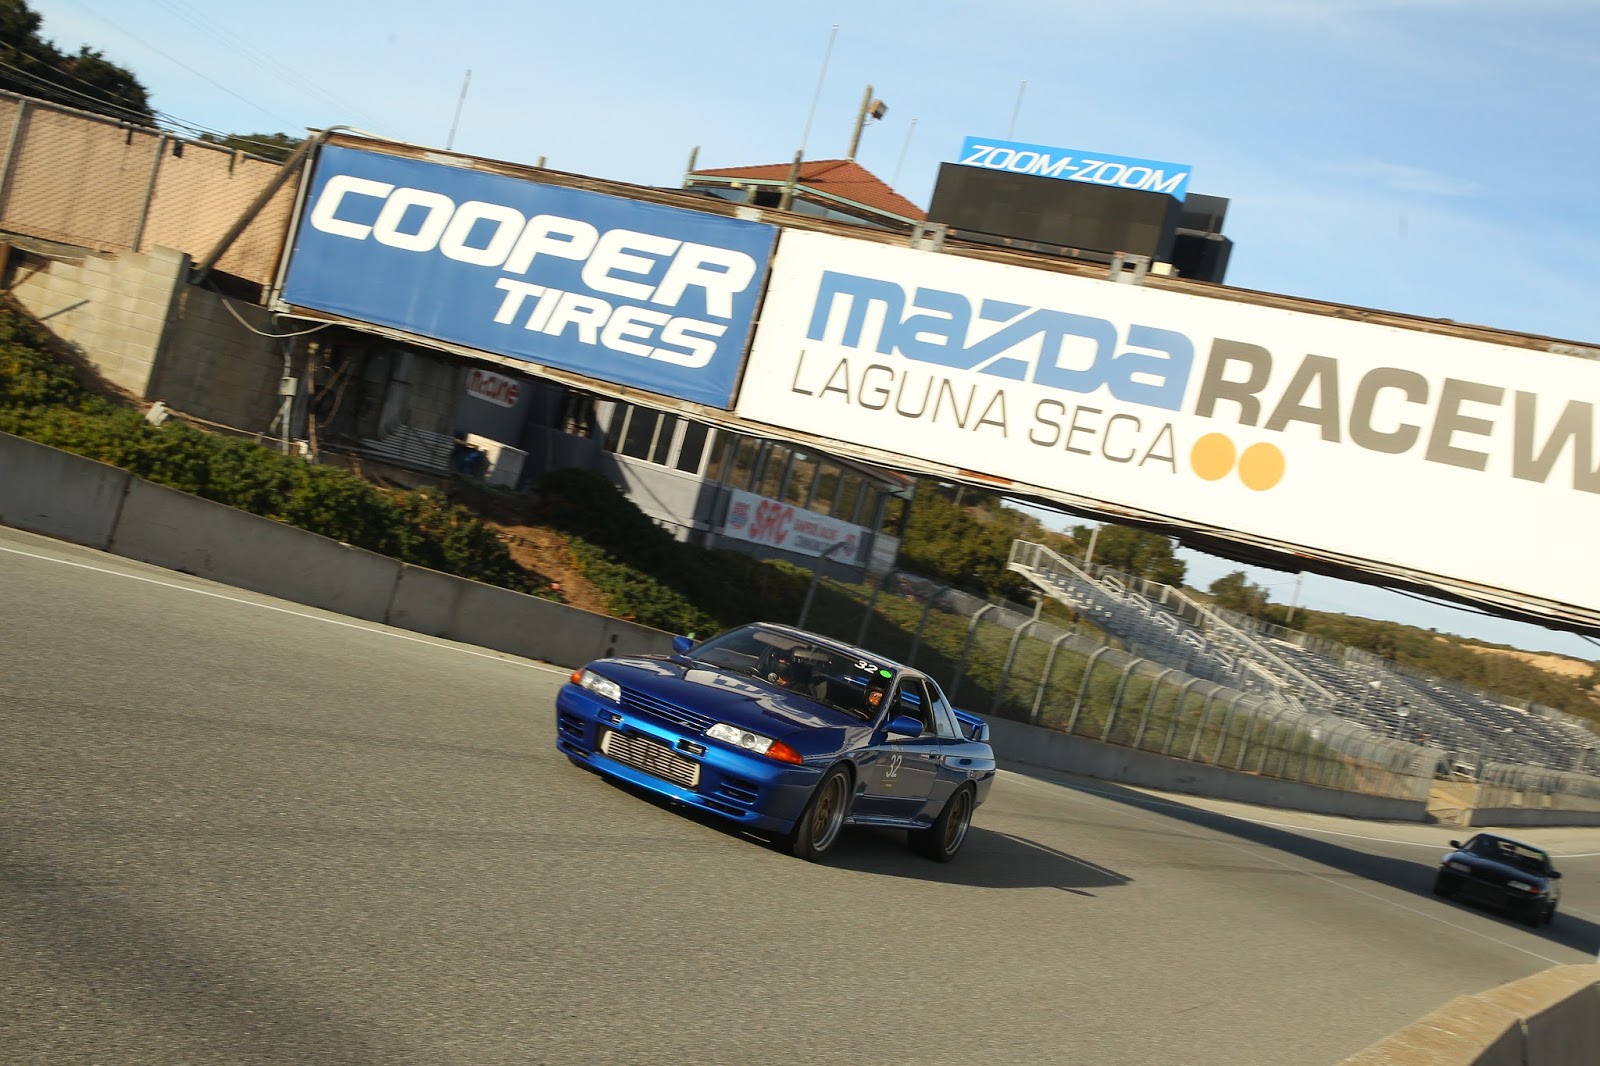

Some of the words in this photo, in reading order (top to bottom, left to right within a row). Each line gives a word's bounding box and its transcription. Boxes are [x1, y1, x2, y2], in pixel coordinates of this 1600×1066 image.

[960, 144, 1188, 193] ZOOM-ZOOM
[310, 174, 757, 319] COOPER
[493, 277, 728, 369] TIRES
[791, 349, 1008, 439] LAGUNA
[1028, 398, 1178, 474] SECA
[854, 660, 878, 674] 32
[886, 754, 902, 777] 32
